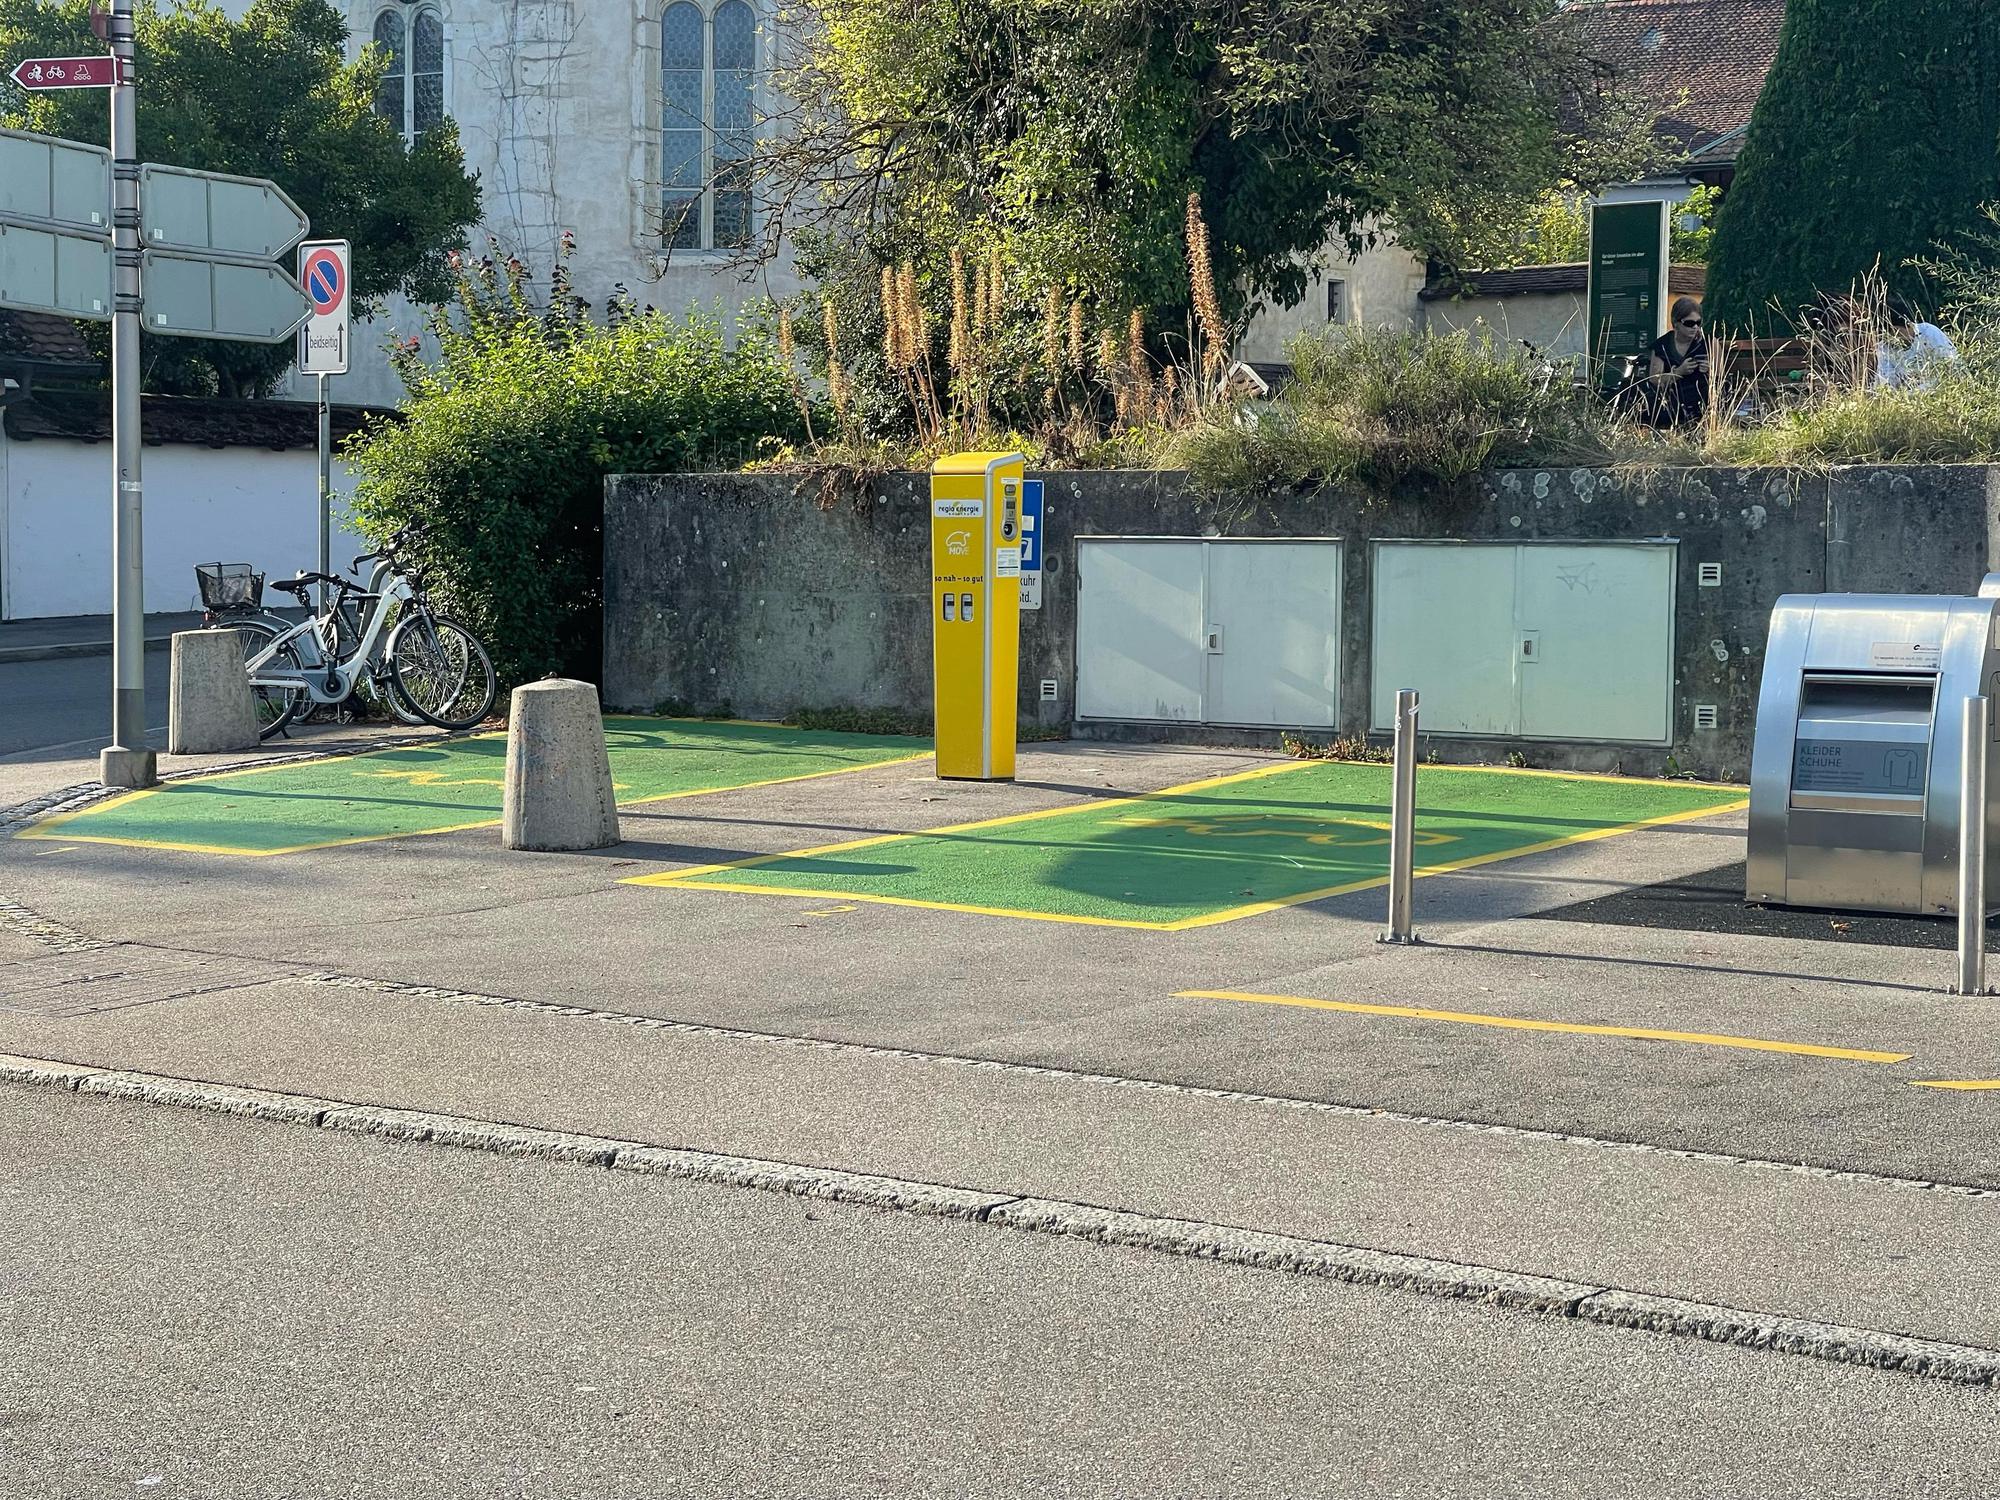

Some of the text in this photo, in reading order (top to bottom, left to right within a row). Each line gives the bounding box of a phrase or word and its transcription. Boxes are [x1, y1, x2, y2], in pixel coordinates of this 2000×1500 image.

[310, 335, 338, 351] beidseitig
[956, 505, 979, 513] energie
[948, 547, 969, 555] MOVE
[971, 576, 984, 584] gut
[1800, 746, 1841, 756] KLEIDER
[1799, 757, 1842, 767] SCHUHE
